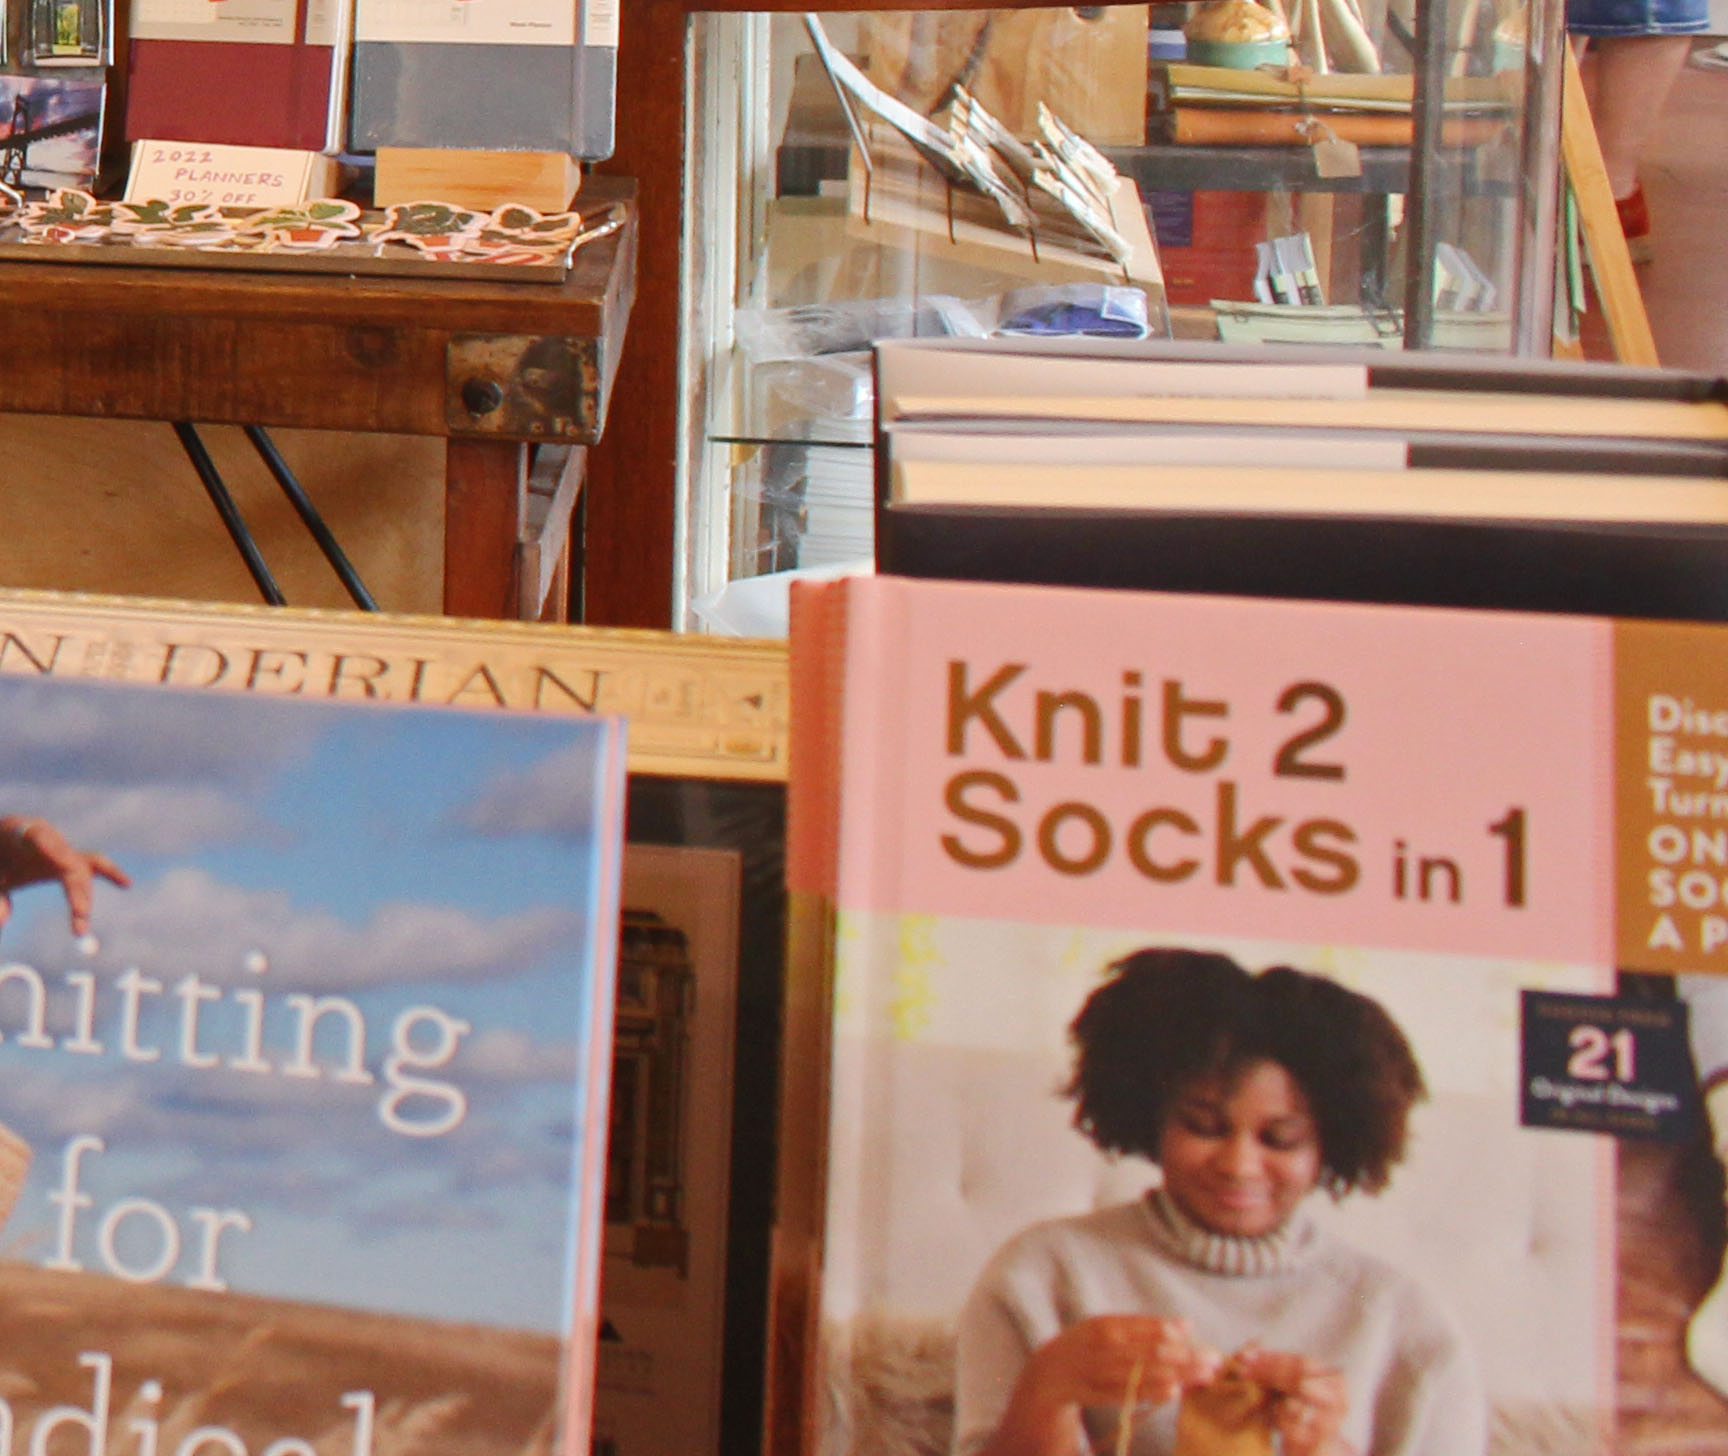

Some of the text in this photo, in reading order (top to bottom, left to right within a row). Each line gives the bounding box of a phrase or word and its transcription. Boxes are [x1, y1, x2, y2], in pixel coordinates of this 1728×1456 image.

[152, 149, 214, 164] 2022
[174, 167, 284, 187] PLANNERS
[169, 189, 257, 204] 30% OFF
[158, 642, 611, 717] DERIAN
[945, 658, 1348, 782] Knit 2
[1648, 735, 1728, 790] Easy
[939, 768, 1528, 909] Socks in 1
[1647, 824, 1728, 867] ON
[1648, 866, 1728, 911] SO
[1646, 912, 1684, 953] A
[1565, 1023, 1638, 1084] 21
[44, 1134, 252, 1292] for
